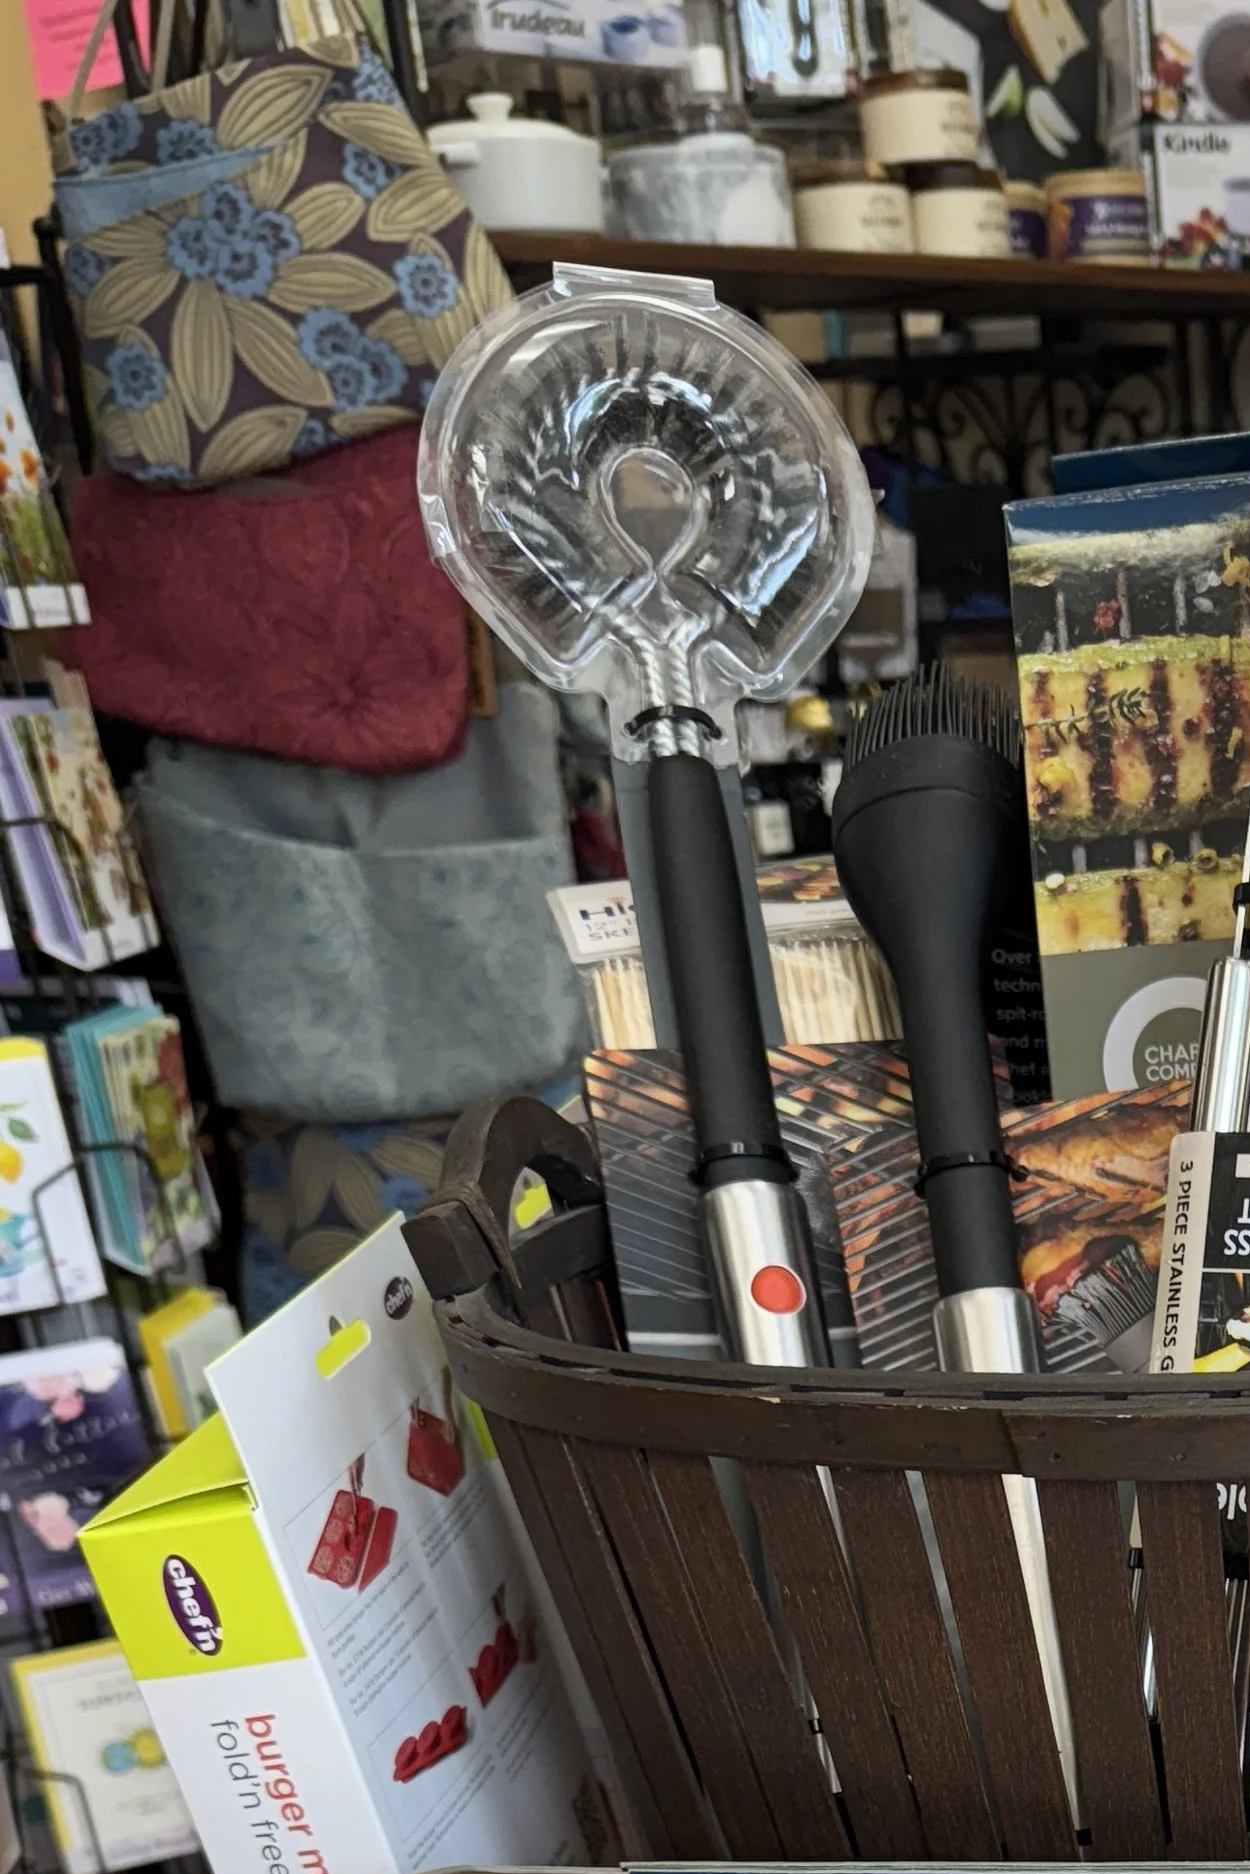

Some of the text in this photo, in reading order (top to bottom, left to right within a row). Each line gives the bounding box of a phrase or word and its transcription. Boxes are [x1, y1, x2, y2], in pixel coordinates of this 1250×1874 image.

[992, 949, 1033, 965] Over
[1174, 1182, 1192, 1235] PIECE
[1180, 1161, 1193, 1172] 3
[1161, 1243, 1190, 1348] STAINLESS
[167, 1557, 223, 1654] chef'n
[210, 1719, 262, 1810] fold'n
[244, 1714, 314, 1838] burger
